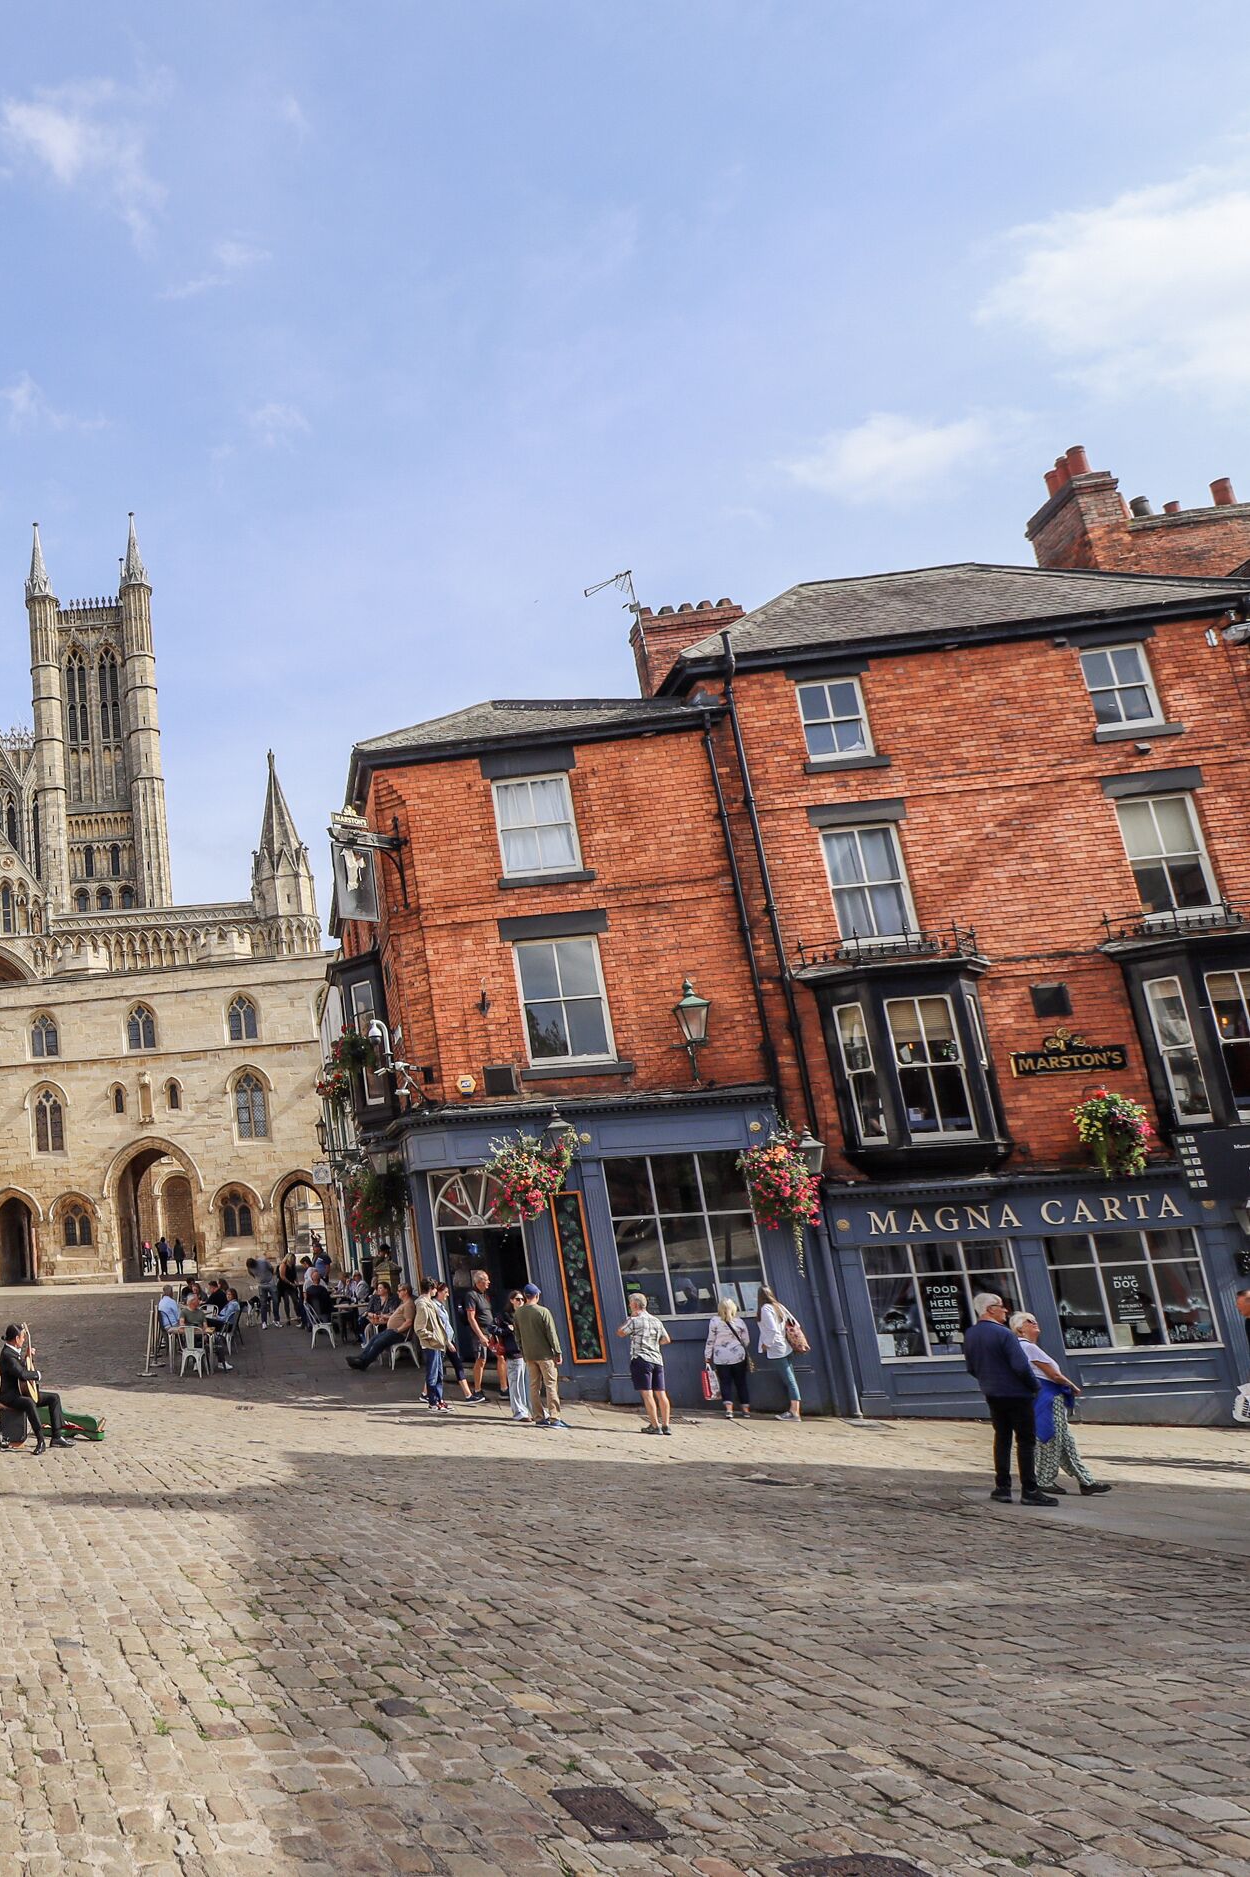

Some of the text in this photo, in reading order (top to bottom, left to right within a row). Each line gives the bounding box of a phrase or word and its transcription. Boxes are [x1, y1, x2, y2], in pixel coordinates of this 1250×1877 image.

[1018, 1051, 1123, 1072] MARSTON'S
[867, 1193, 1184, 1236] MAGNA CARTA
[1113, 1280, 1139, 1289] DOG
[926, 1285, 958, 1294] FOOD
[930, 1299, 958, 1308] HERE
